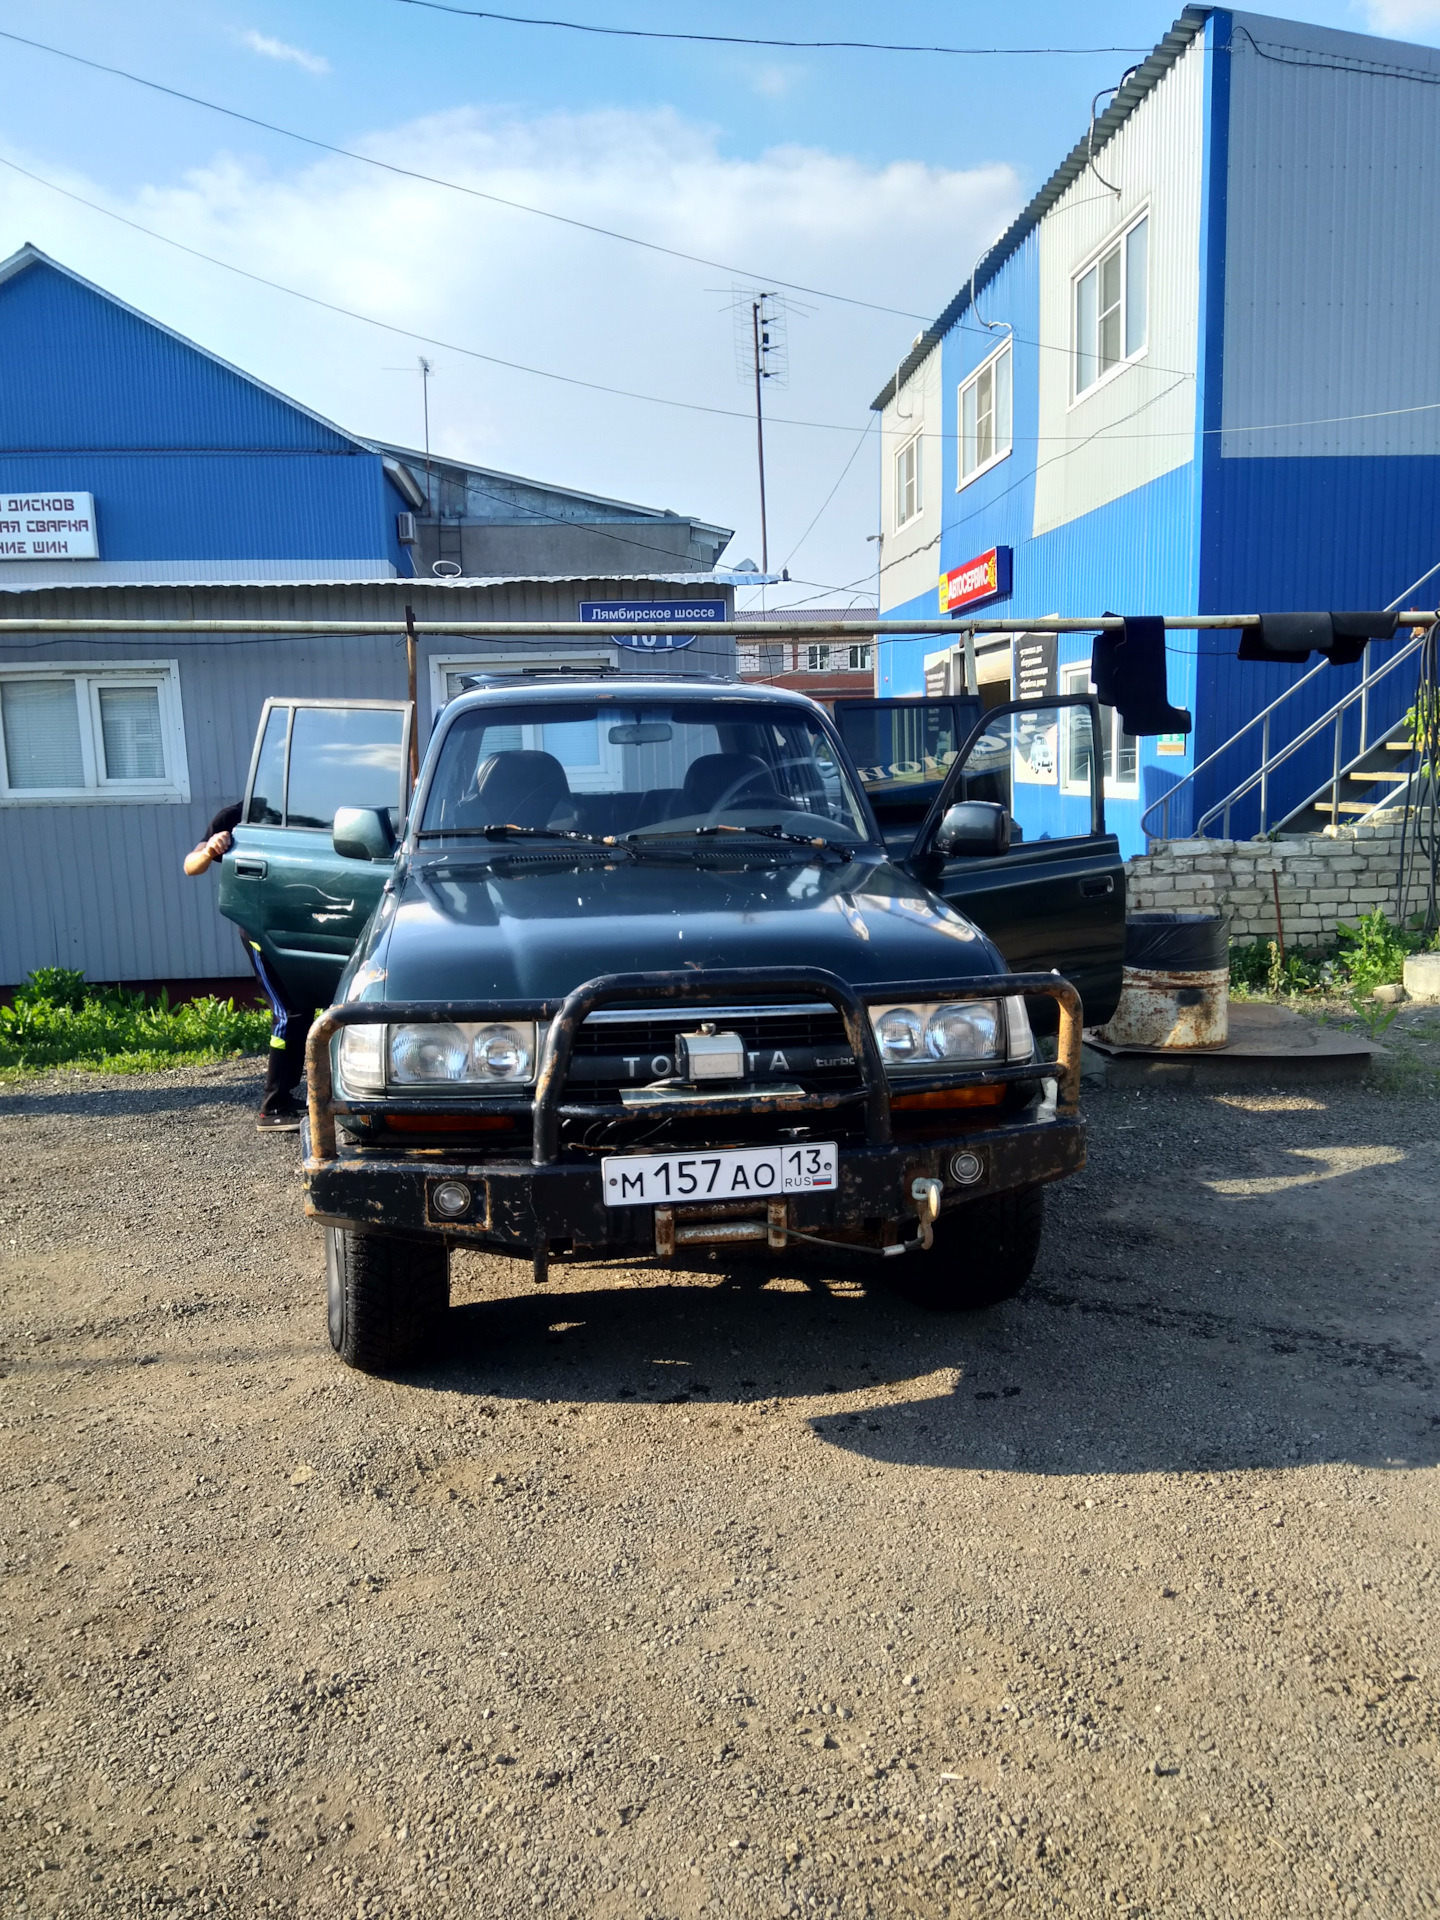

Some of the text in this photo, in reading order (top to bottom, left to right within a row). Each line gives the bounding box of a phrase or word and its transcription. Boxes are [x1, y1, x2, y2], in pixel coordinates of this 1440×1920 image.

[8, 499, 75, 512] ДИСКОВ
[26, 519, 89, 533] СВАРКА
[33, 541, 69, 553] ШИН
[948, 562, 989, 601] АВТОСЕРВИС
[591, 608, 715, 622] Лямбирское шоссе
[622, 1051, 790, 1078] TOTA
[788, 1149, 821, 1176] 13
[785, 1176, 811, 1188] RUS
